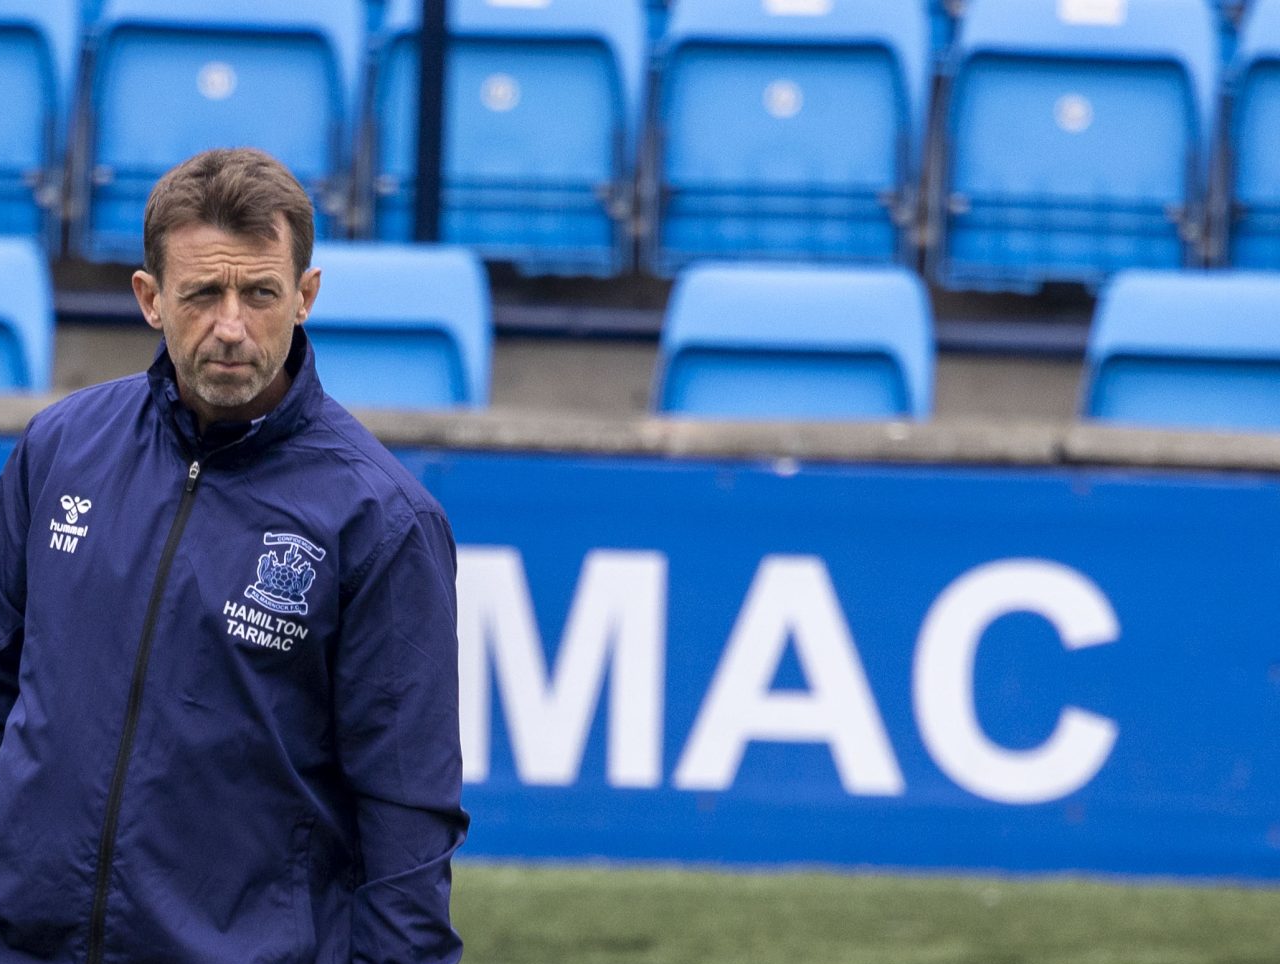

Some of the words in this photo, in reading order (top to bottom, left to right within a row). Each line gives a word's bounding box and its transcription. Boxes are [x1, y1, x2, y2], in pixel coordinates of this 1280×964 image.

[49, 518, 89, 537] hummel
[49, 532, 79, 554] NM
[223, 600, 309, 640] HAMILTON
[226, 619, 294, 651] TARMAC
